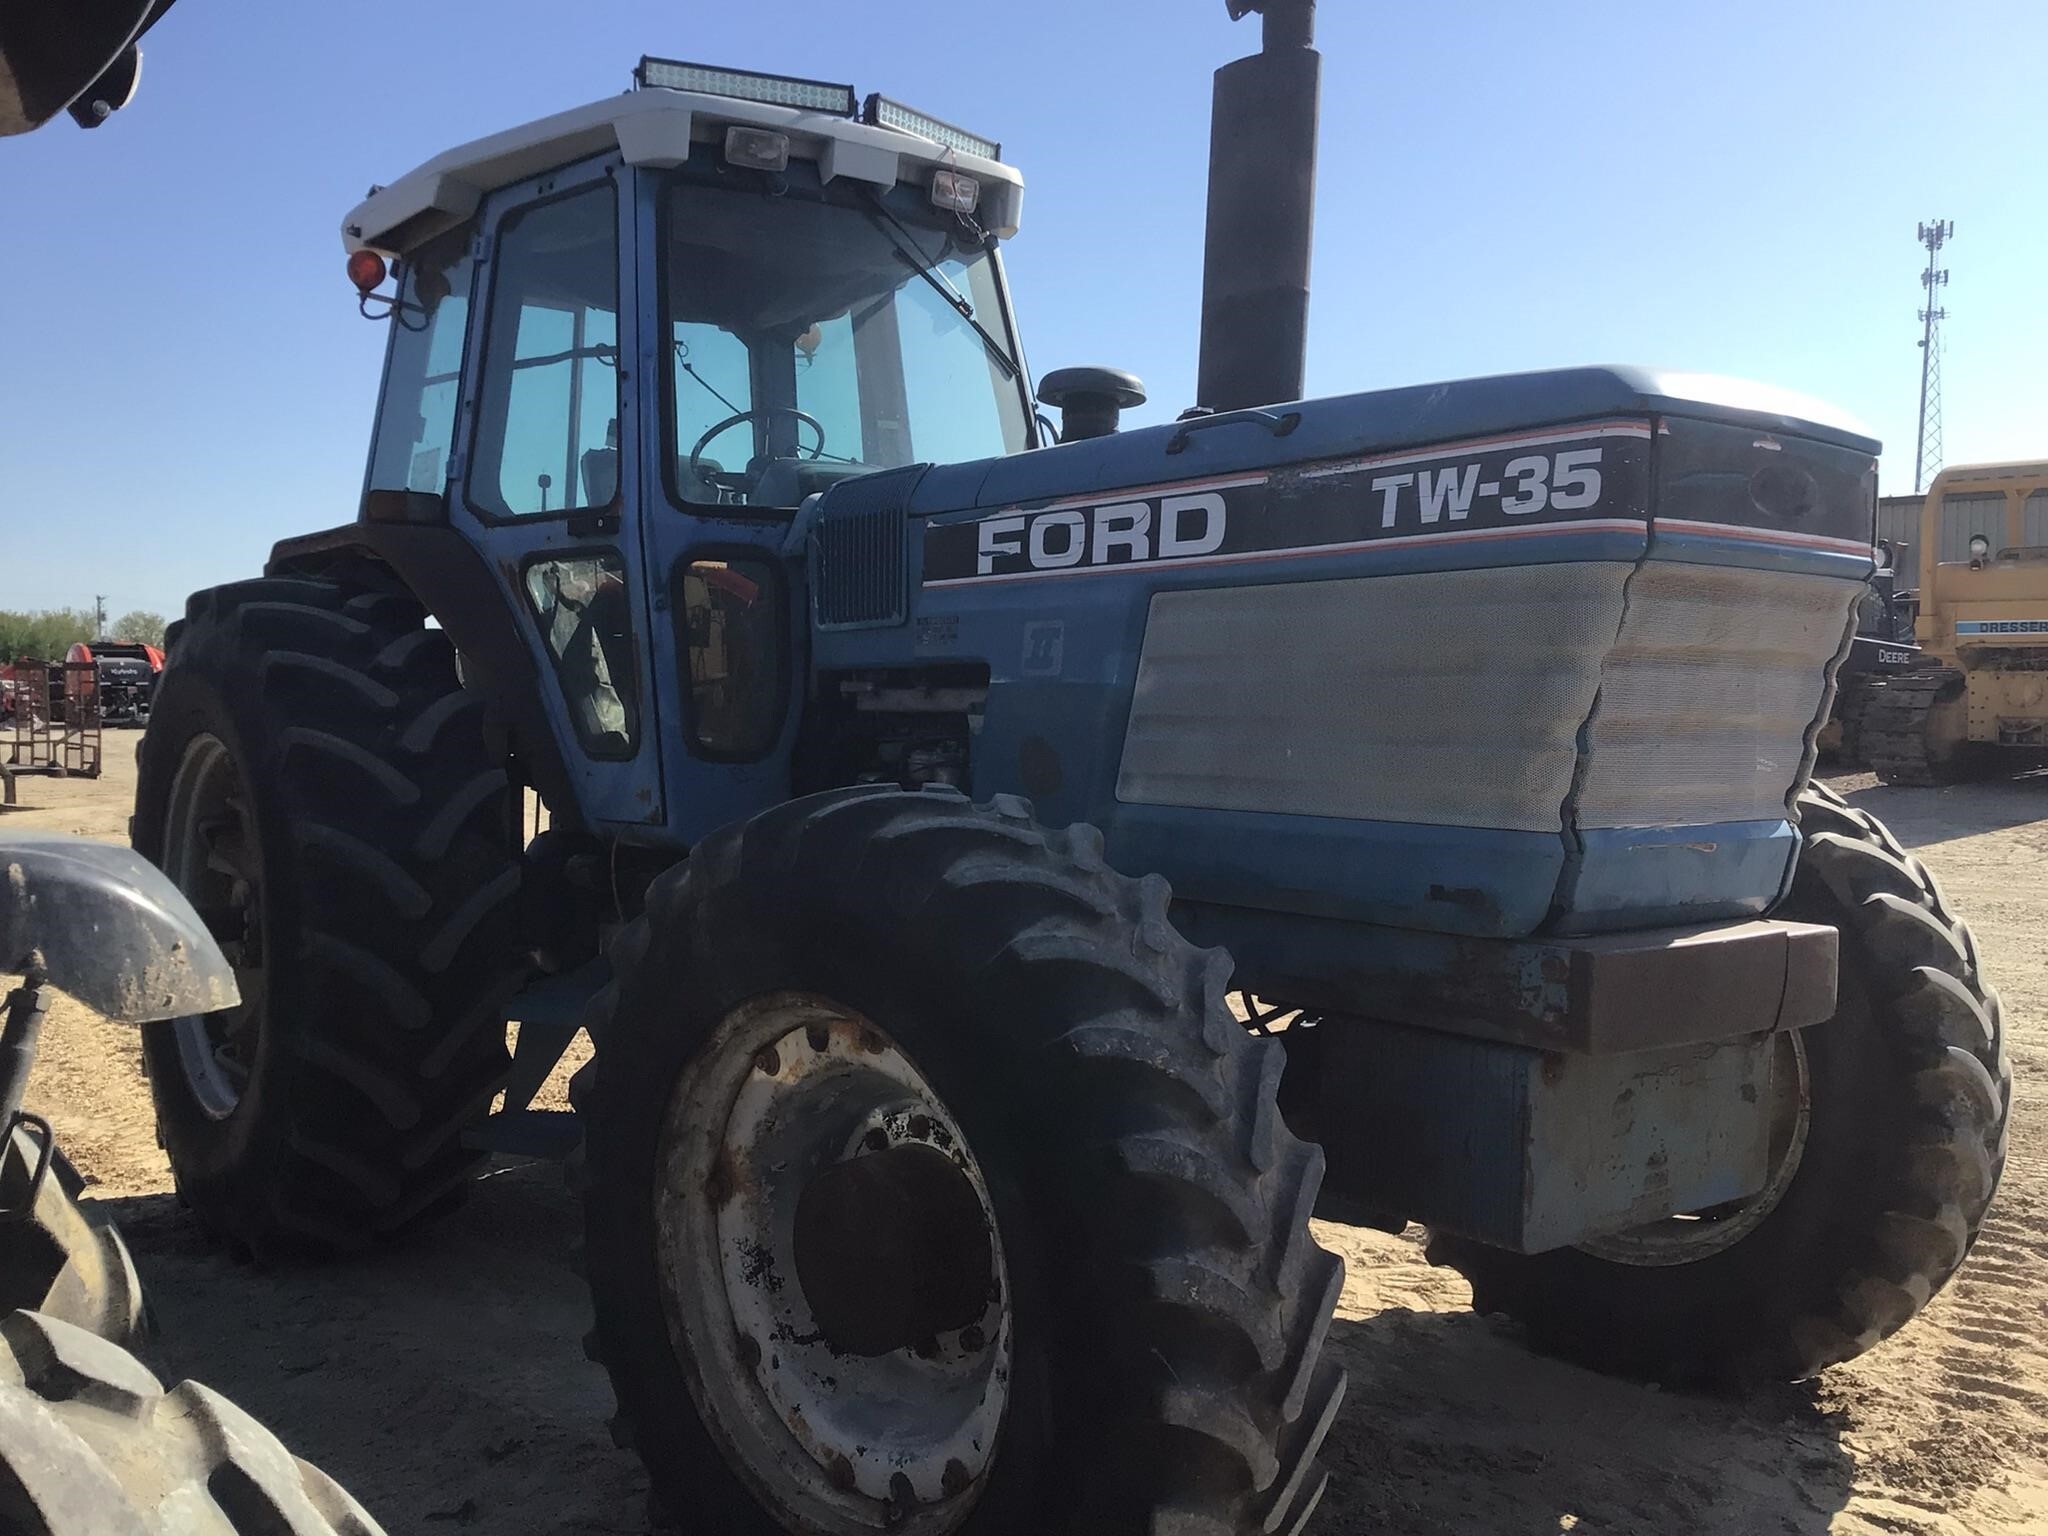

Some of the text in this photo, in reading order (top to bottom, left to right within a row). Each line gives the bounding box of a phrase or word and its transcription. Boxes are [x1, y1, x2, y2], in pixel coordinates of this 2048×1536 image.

[977, 447, 1603, 575] FORD TW-35
[1979, 621, 2048, 633] DRESSER
[1878, 649, 1910, 664] DEERE
